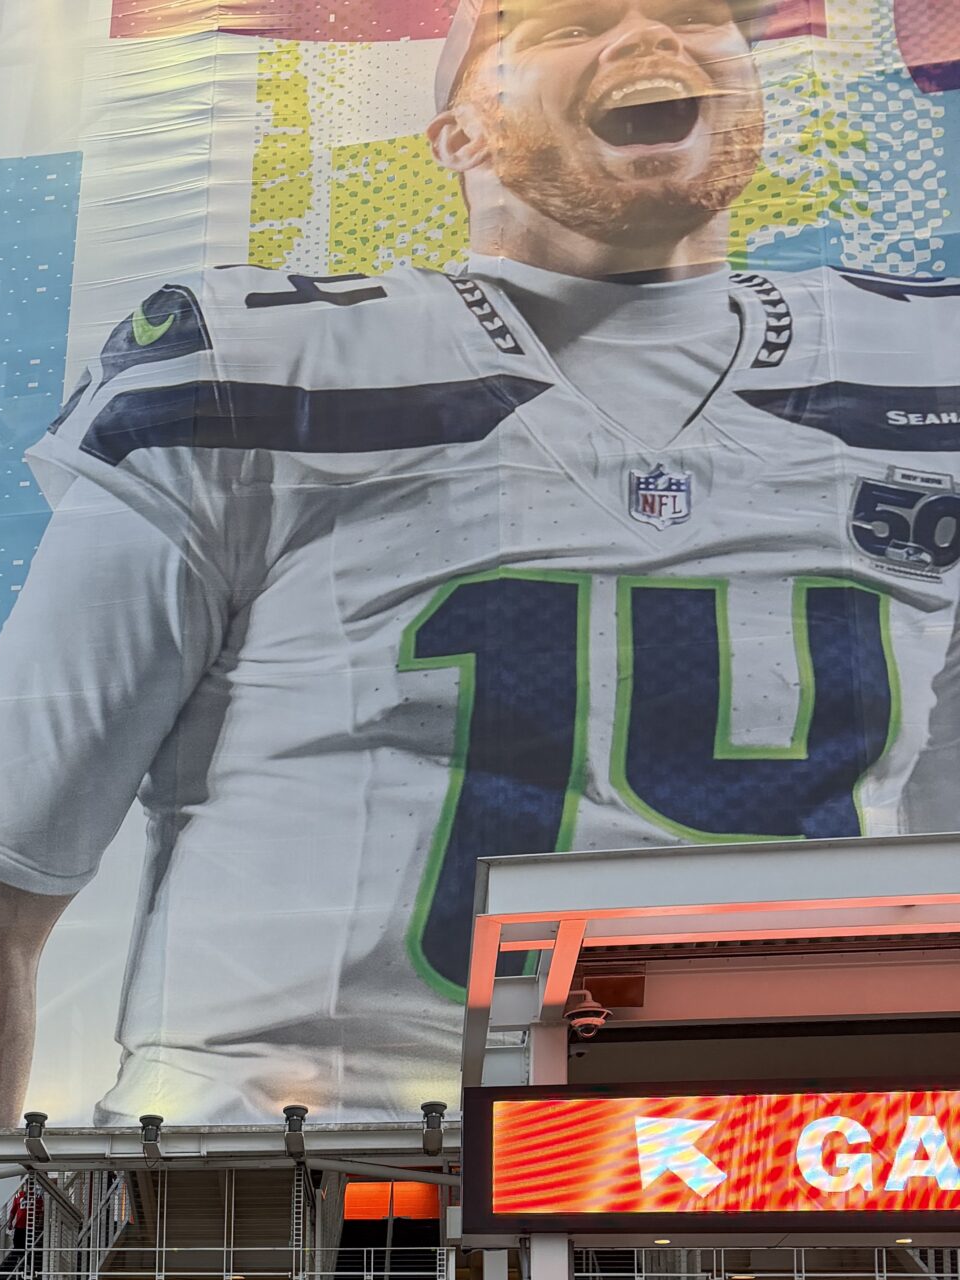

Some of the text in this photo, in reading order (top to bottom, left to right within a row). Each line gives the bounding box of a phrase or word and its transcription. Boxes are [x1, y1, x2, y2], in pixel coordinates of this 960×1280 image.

[886, 410, 960, 425] SEAH
[641, 493, 683, 517] NFL
[851, 479, 960, 568] 50
[796, 1115, 960, 1192] GA
